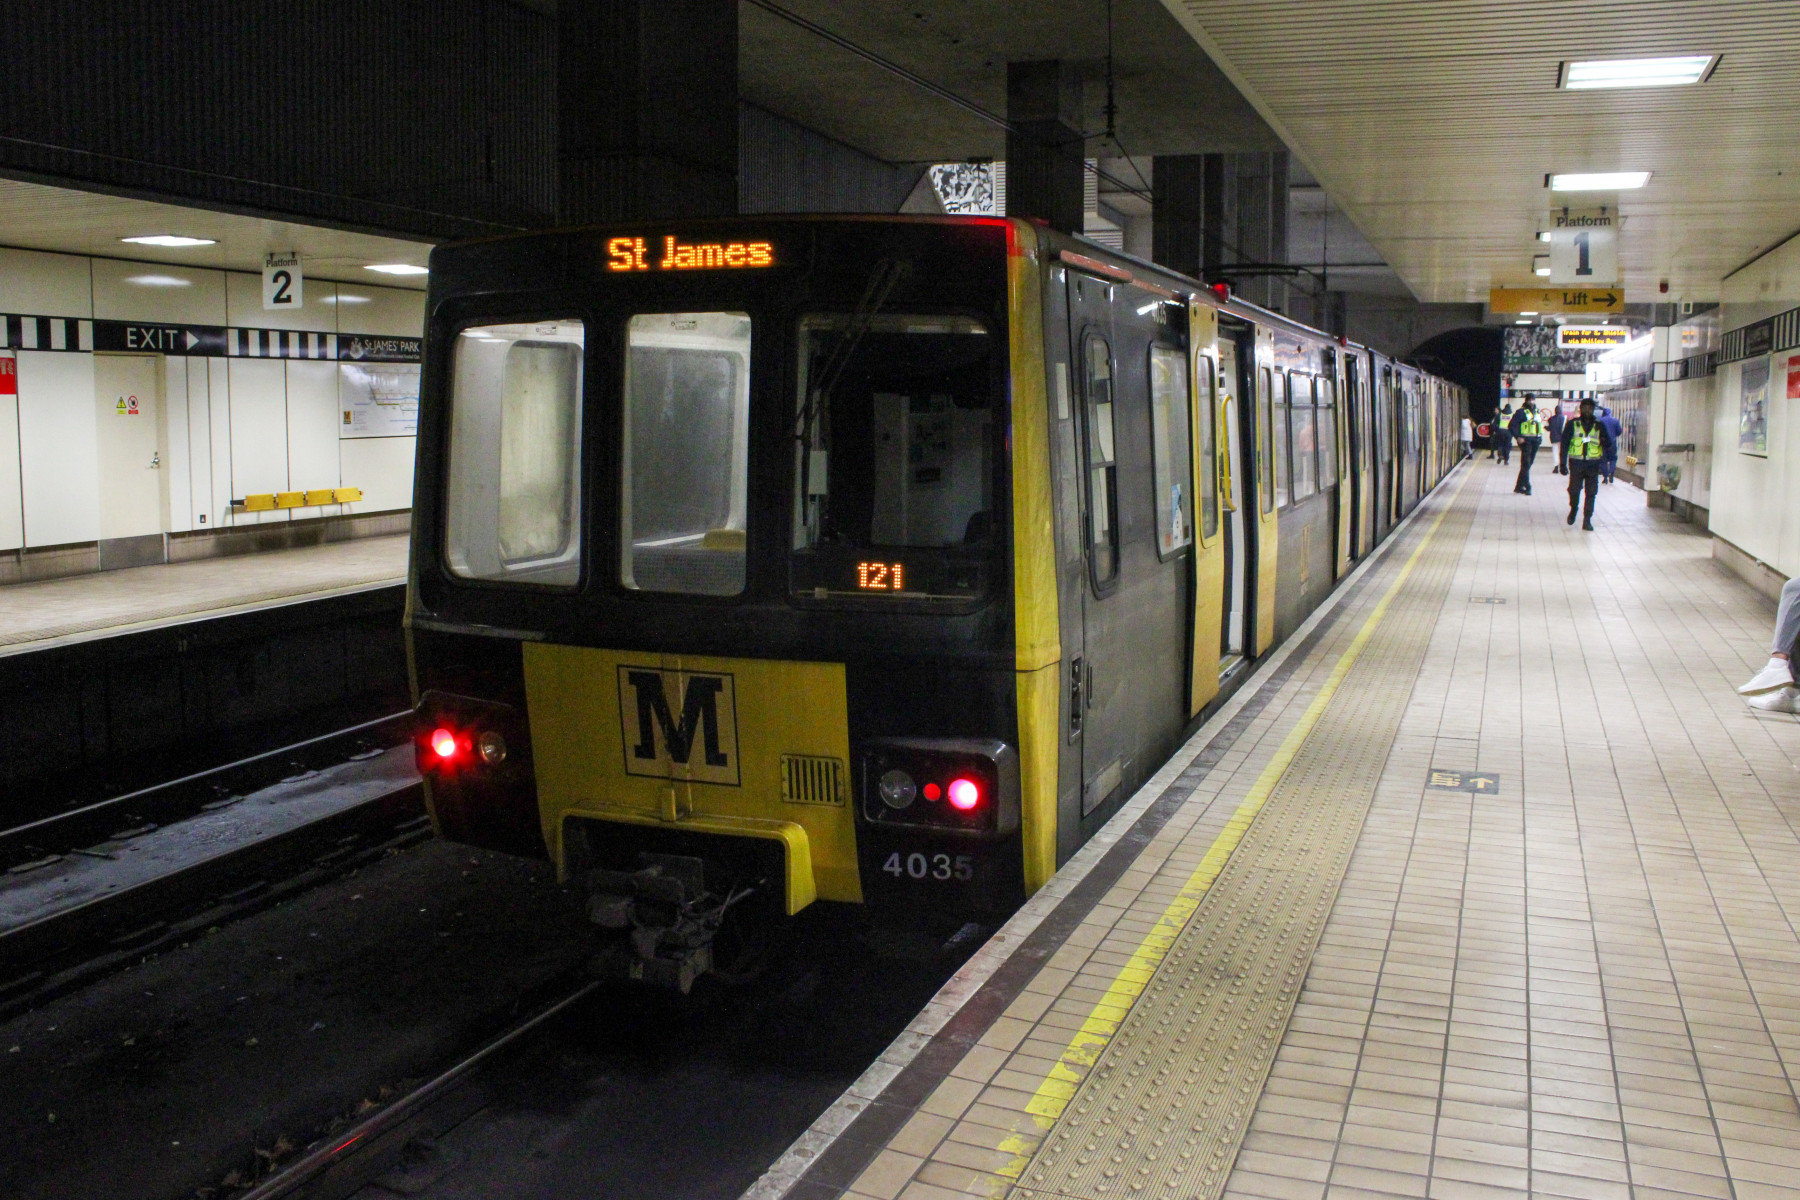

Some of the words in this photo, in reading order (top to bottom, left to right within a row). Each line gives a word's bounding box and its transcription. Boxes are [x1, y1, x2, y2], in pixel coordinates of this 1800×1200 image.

[1556, 215, 1611, 227] Platform
[266, 258, 298, 267] Platform
[609, 237, 648, 269] St
[661, 235, 772, 268] James
[1574, 231, 1592, 275] 1
[272, 270, 292, 304] 2
[1563, 291, 1588, 305] Lift
[126, 327, 178, 349] EXIT
[400, 341, 420, 352] PARK
[858, 563, 901, 588] 121
[628, 671, 728, 767] M
[882, 852, 973, 879] 4035
